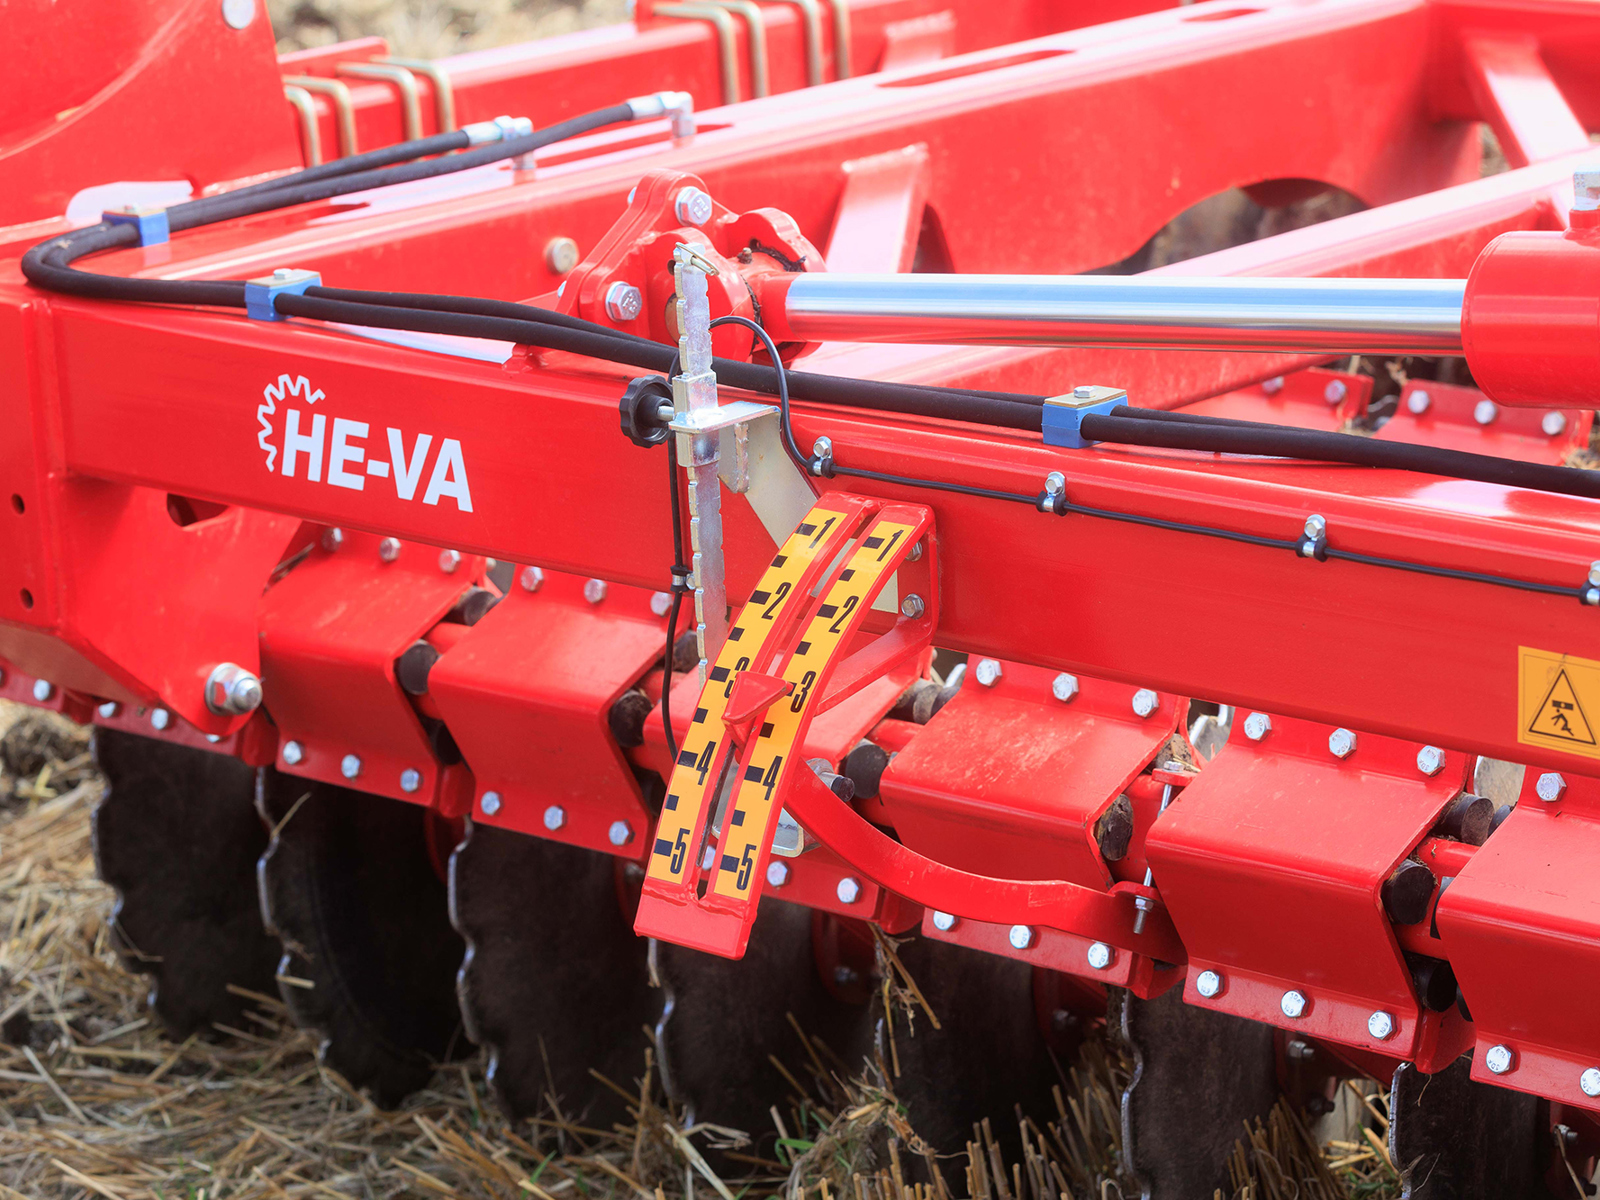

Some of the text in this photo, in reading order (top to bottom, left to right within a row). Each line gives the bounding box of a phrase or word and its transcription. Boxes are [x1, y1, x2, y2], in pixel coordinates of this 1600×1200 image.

[281, 408, 474, 513] HE-VA
[808, 516, 837, 549] 1
[876, 529, 905, 562] 1
[761, 581, 792, 620] 2
[828, 595, 860, 634] 2
[790, 670, 817, 713] 3
[696, 740, 717, 786] 4
[762, 755, 783, 801] 4
[669, 827, 691, 875] 5
[736, 843, 757, 891] 5
